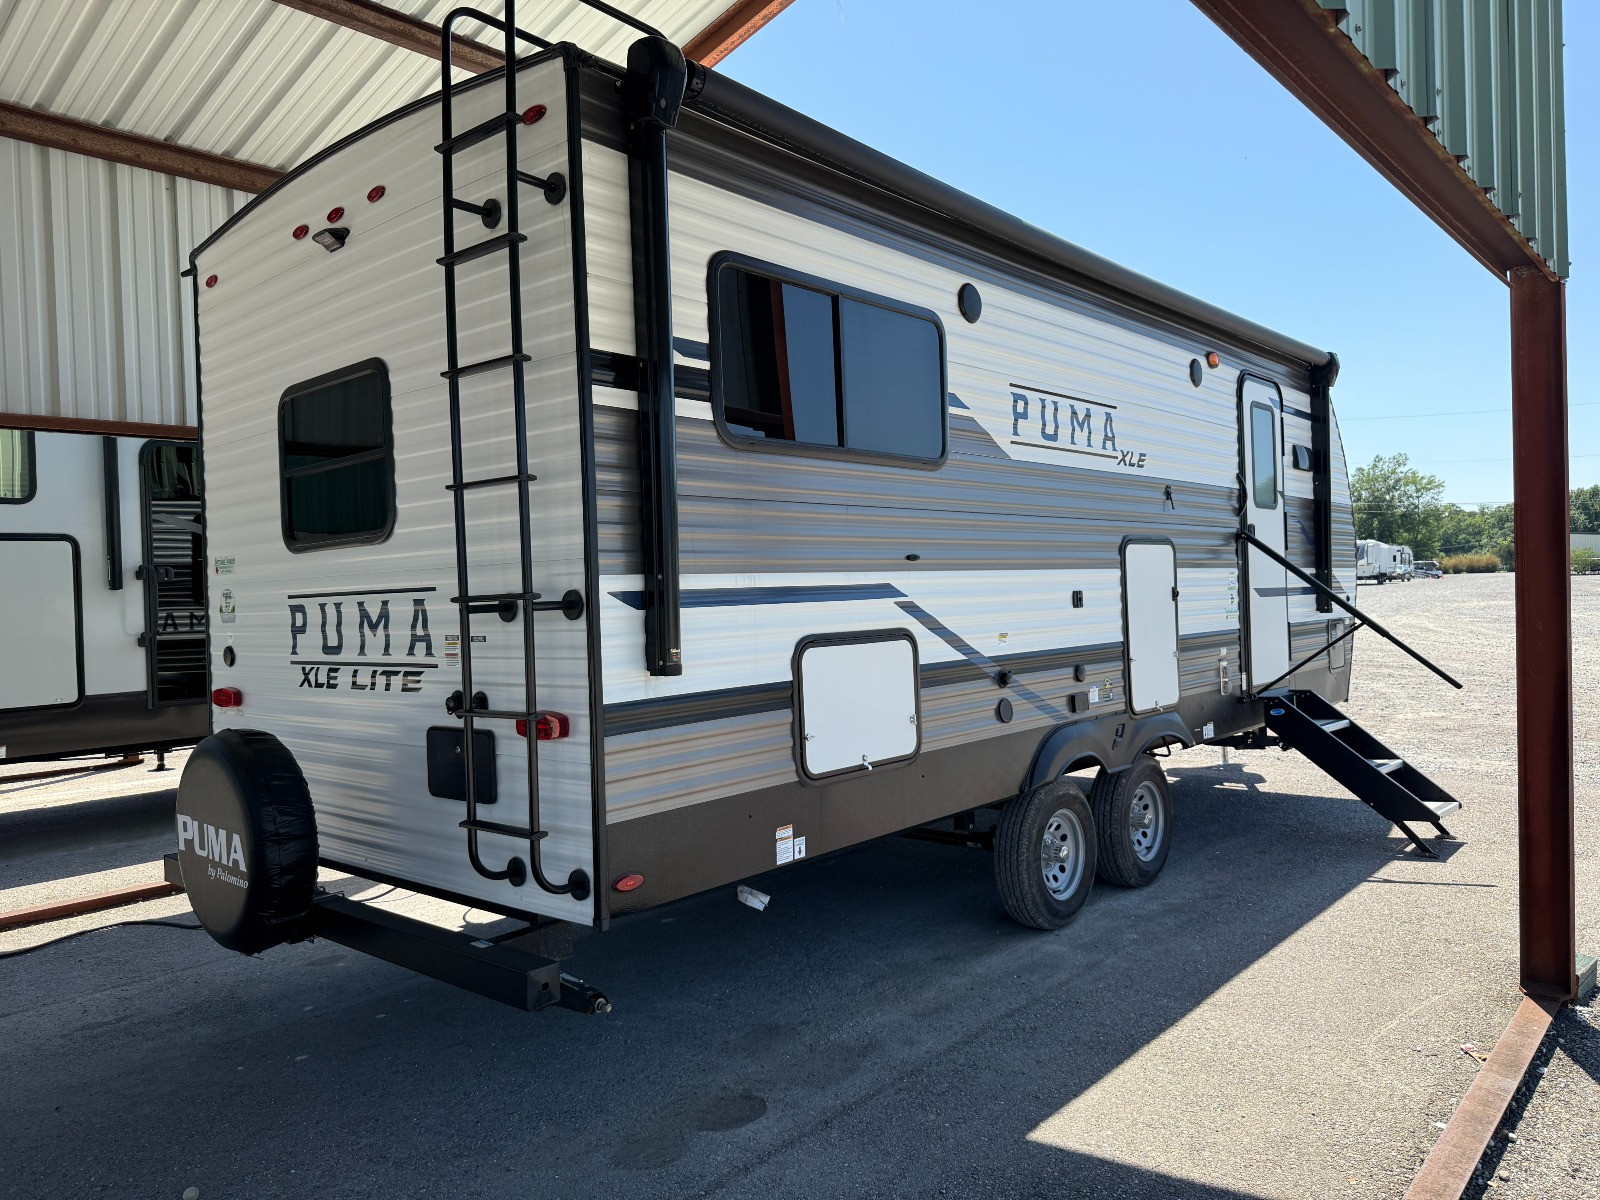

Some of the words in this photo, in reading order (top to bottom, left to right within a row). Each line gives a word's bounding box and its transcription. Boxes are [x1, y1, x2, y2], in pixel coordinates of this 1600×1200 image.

[1010, 391, 1118, 452] PUMA
[1117, 449, 1147, 469] XLE
[287, 598, 437, 657] PUMA
[298, 666, 341, 690] XLE
[350, 668, 425, 693] LITE
[176, 813, 247, 873] PUMA
[207, 863, 216, 880] by
[216, 867, 249, 889] Palomino
